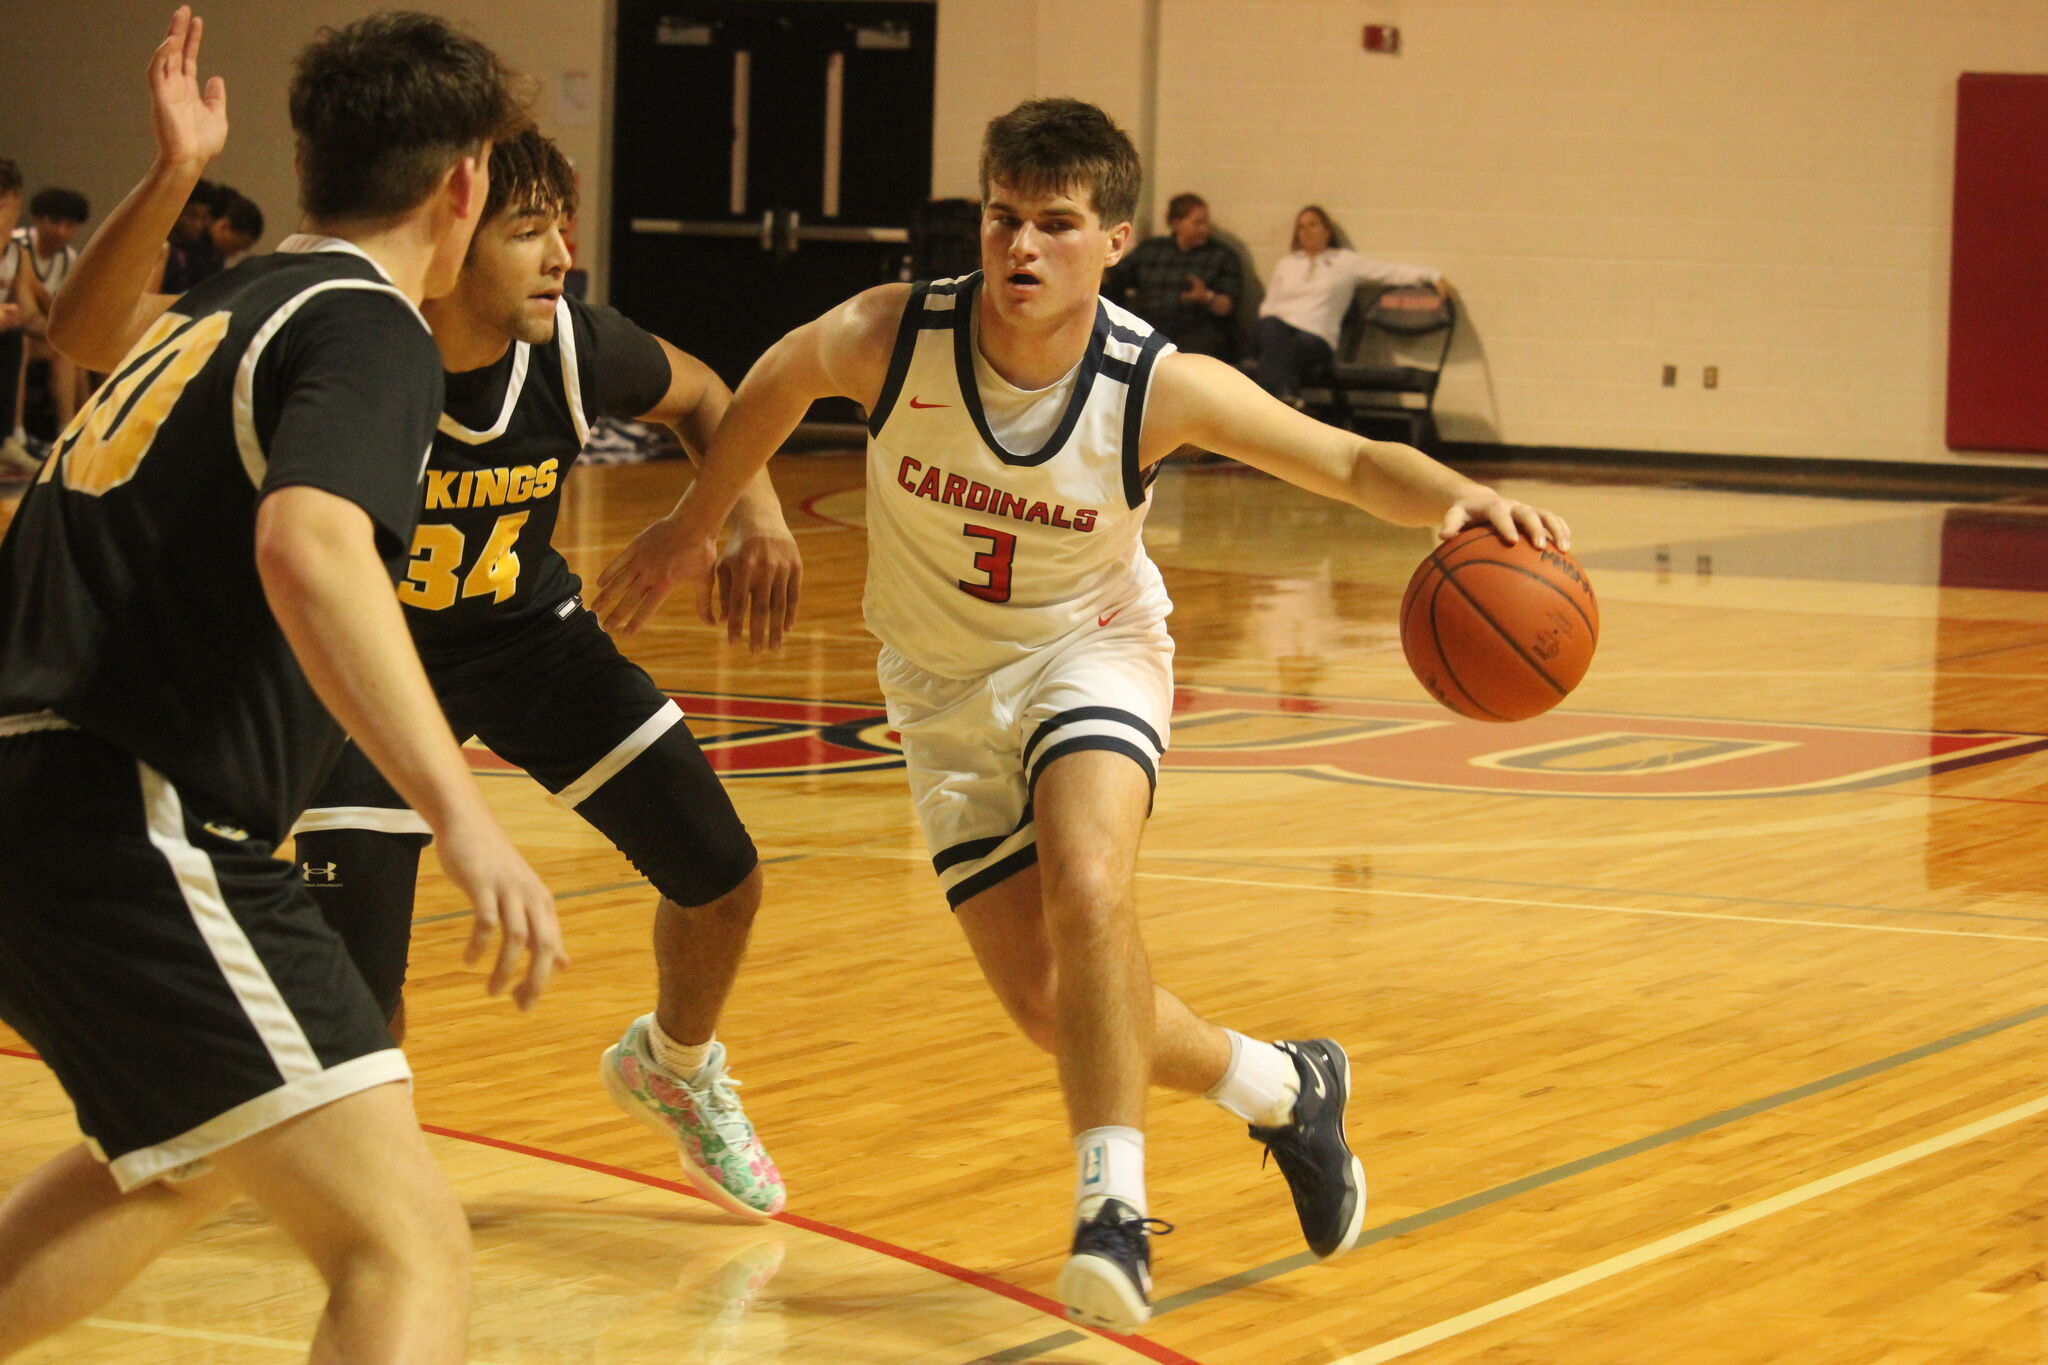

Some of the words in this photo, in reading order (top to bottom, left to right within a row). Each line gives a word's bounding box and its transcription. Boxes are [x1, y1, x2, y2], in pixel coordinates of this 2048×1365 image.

[898, 456, 1098, 533] CARDINALS
[397, 510, 530, 611] 34
[959, 523, 1017, 603] 3
